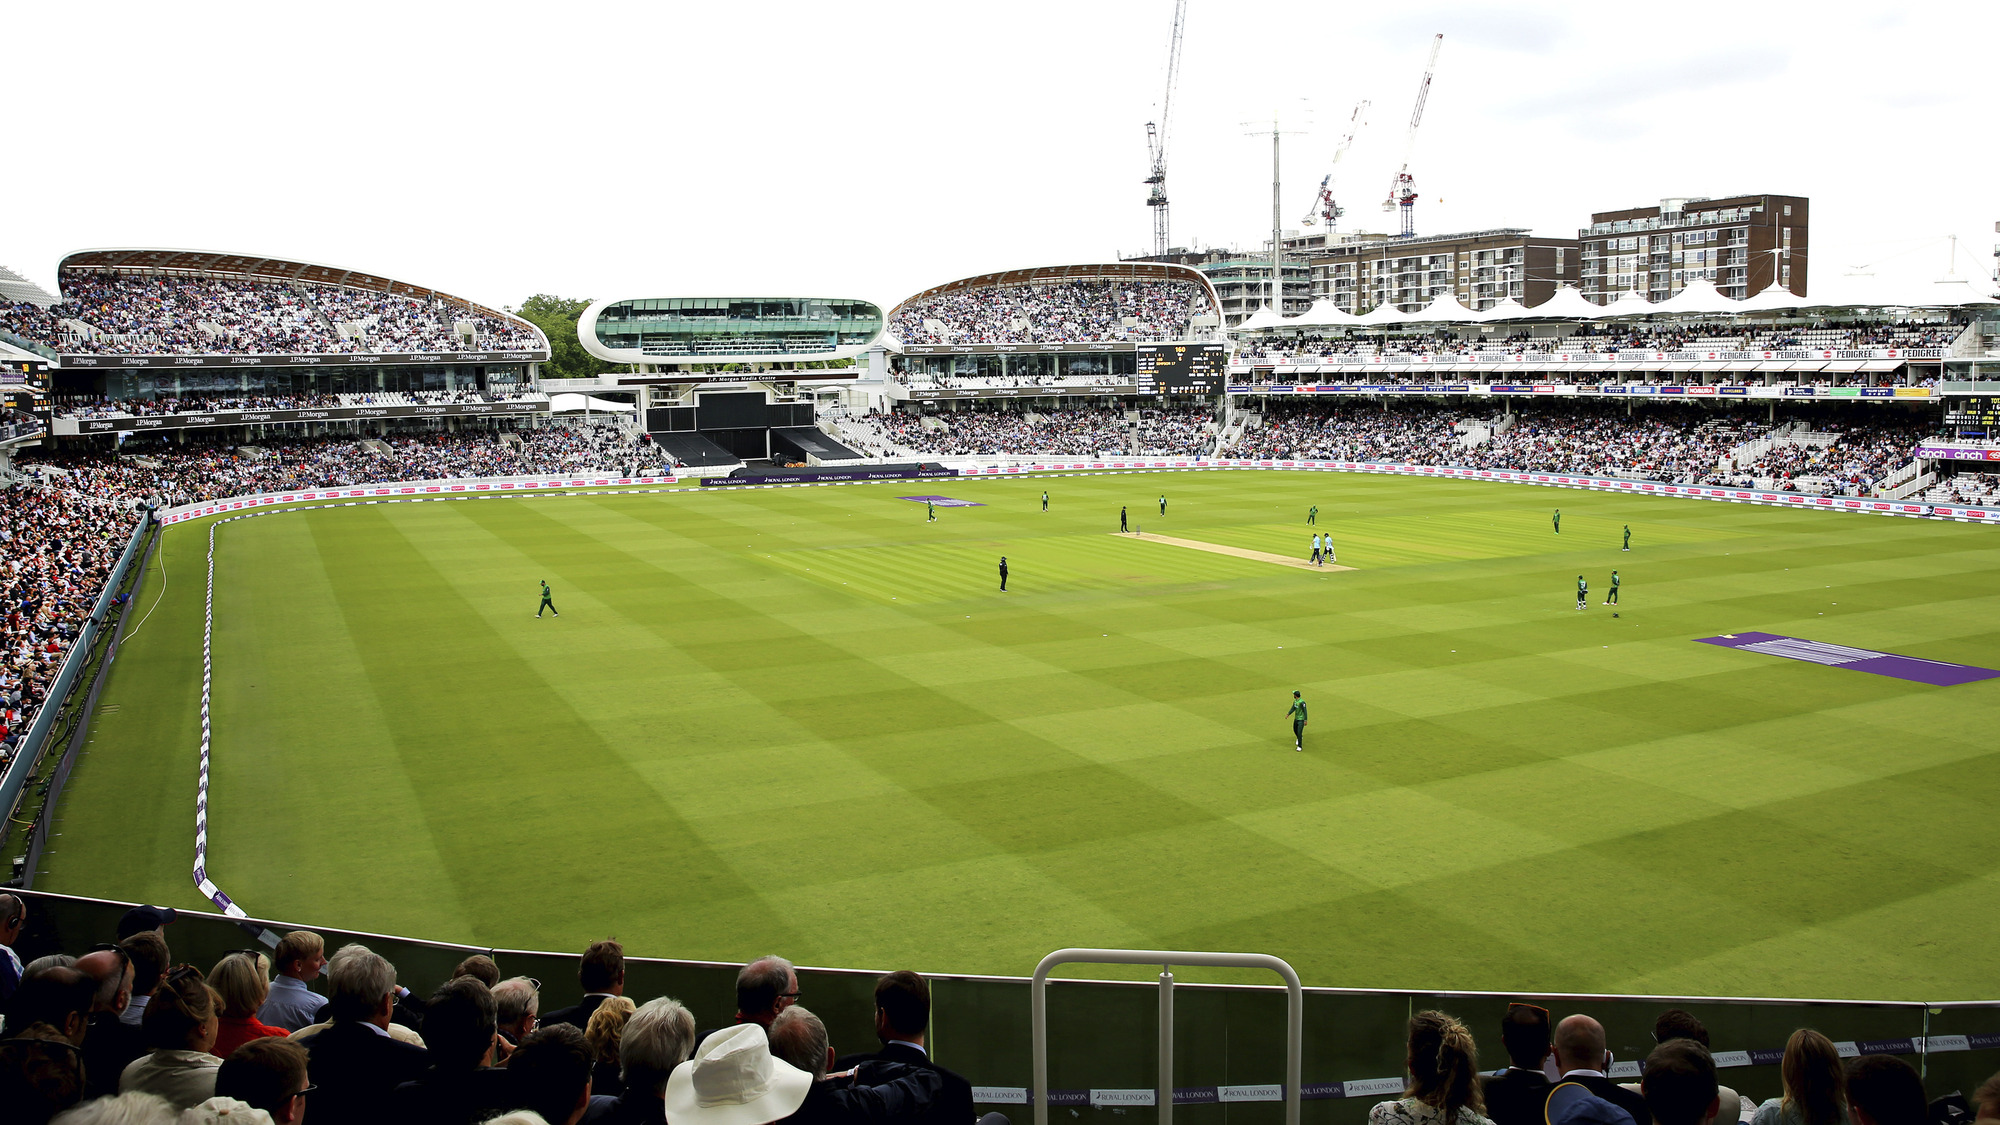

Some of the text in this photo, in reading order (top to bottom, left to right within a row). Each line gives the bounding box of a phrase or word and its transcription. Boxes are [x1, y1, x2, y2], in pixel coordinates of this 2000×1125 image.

[1919, 448, 1947, 458] cinch
[1954, 449, 1982, 459] cinch
[1725, 1055, 1747, 1063] LONDON
[1611, 1065, 1637, 1073] LONDON
[1313, 1086, 1341, 1094] LONDON
[1375, 1082, 1401, 1090] LONDON
